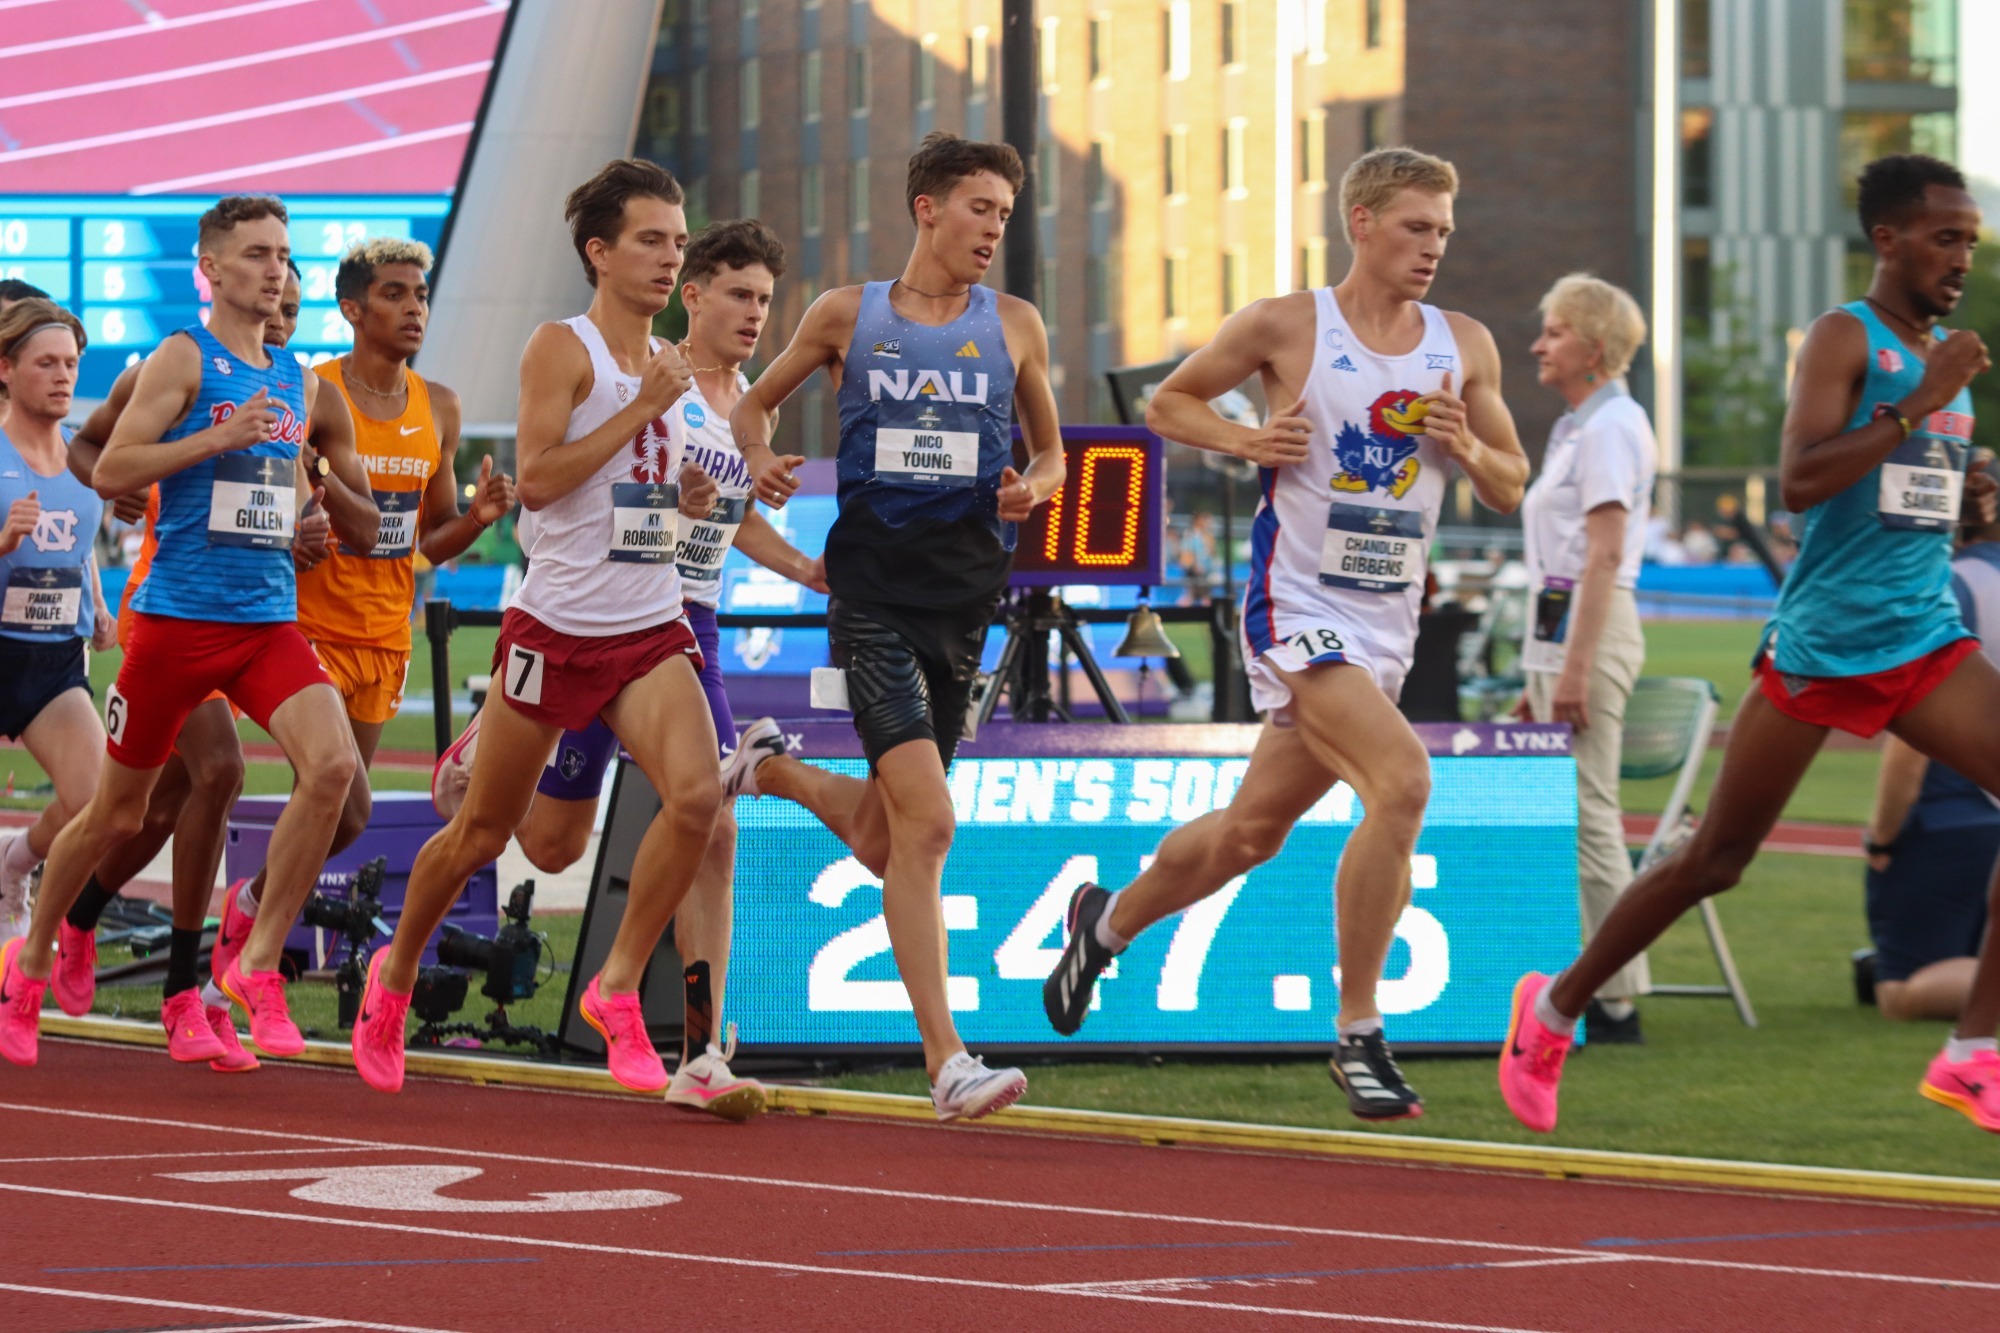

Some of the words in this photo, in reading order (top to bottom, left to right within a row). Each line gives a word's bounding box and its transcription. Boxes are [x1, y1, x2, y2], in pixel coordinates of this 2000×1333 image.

[102, 310, 125, 343] 6
[867, 369, 988, 404] NAU
[914, 435, 943, 449] NICO
[902, 452, 952, 470] YOUNG
[1364, 445, 1394, 468] KU
[236, 508, 282, 531] GILLEN
[648, 513, 660, 526] KY
[622, 529, 674, 546] ROBINSON
[690, 525, 725, 544] DYLAN
[1345, 537, 1407, 556] CHANDLER
[1341, 555, 1404, 577] GIBBENS
[28, 592, 63, 603] PARKER
[24, 606, 62, 620] WOLFE
[1295, 629, 1344, 657] 18
[513, 649, 536, 697] 7
[108, 696, 123, 736] 6
[1495, 730, 1568, 750] LYNX
[319, 873, 346, 886] YNX
